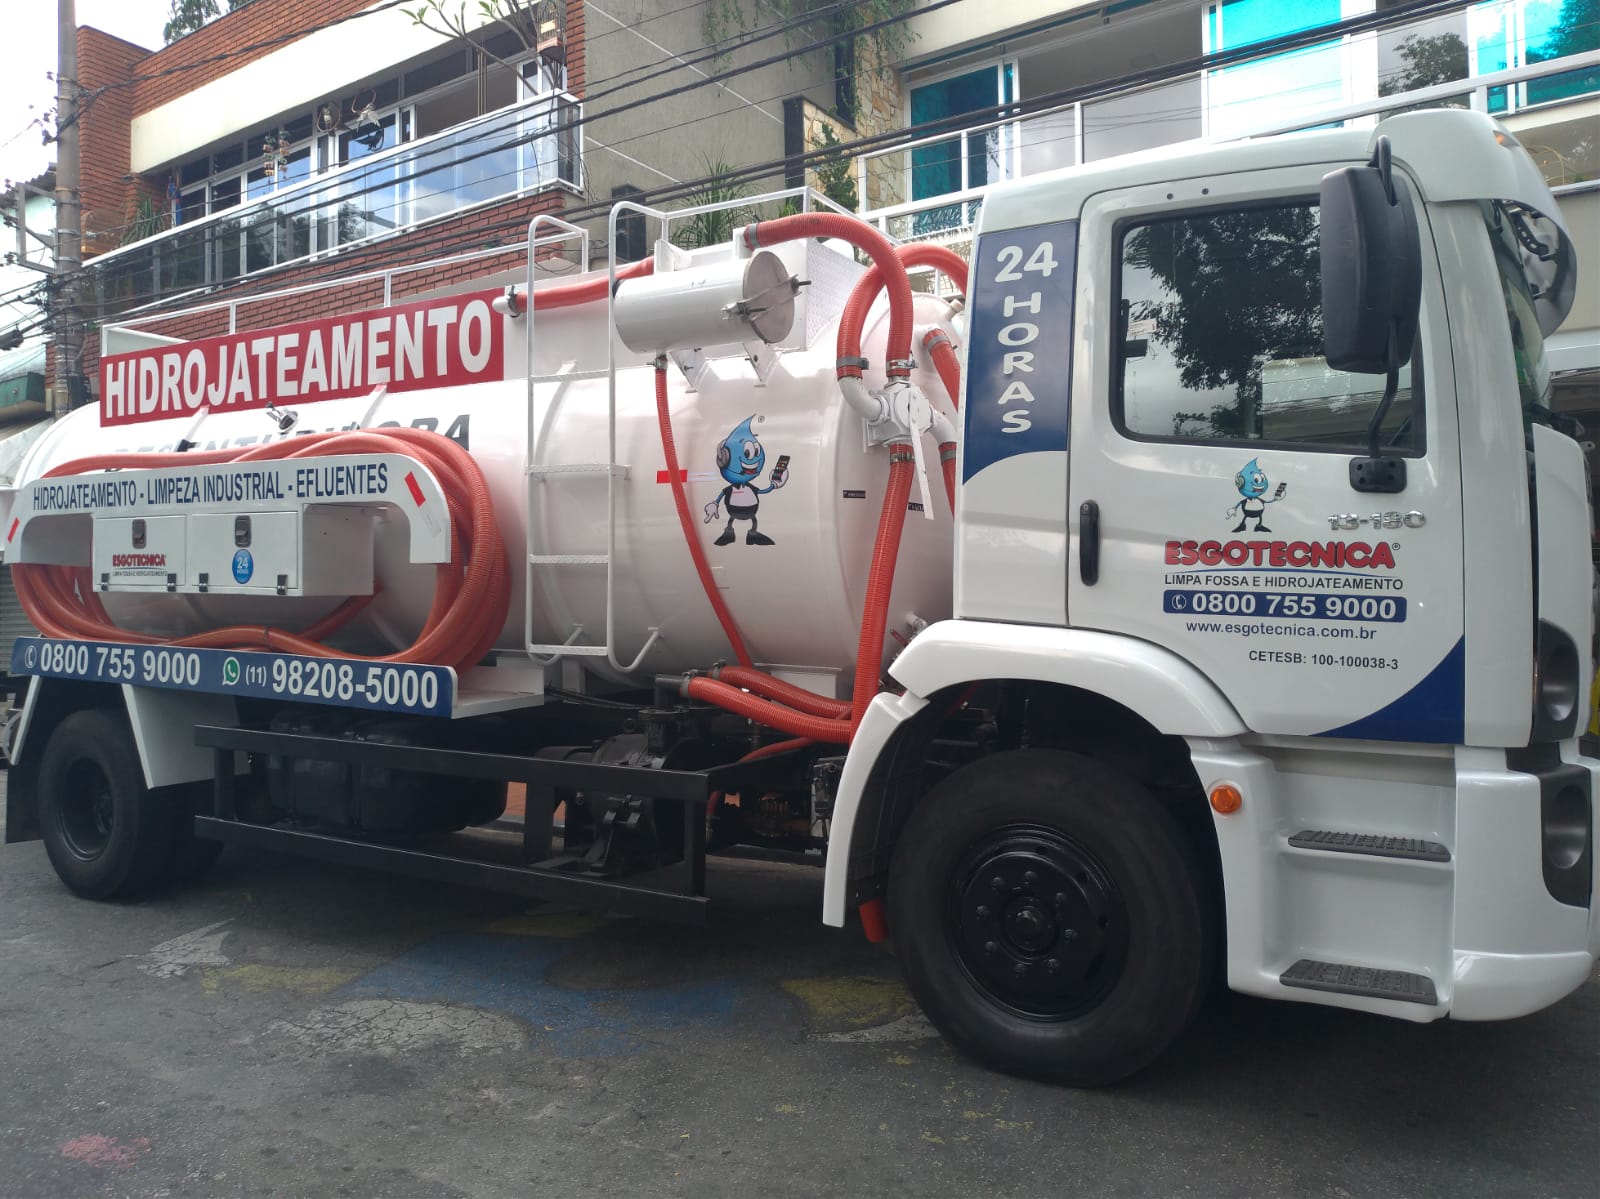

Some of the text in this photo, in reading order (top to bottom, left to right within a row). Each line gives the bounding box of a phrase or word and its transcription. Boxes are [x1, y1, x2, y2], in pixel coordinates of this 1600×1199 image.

[995, 241, 1058, 283] 24
[105, 299, 492, 419] HIDROJATEAMENTO
[998, 291, 1042, 433] HORAS
[33, 481, 137, 511] HIDROJATEAMENTO
[147, 473, 200, 505] LIMPEZA
[203, 470, 284, 502] INDUSTRIAL
[297, 462, 388, 498] EFLUENTES
[237, 556, 248, 570] 24
[1164, 540, 1396, 569] ESGOTECNICA
[1164, 574, 1403, 590] LIMPA FOSSA E HIDROJATEAMENTO
[1192, 592, 1397, 619] 0800 755 9000
[1186, 622, 1377, 639] www.esgotecnica.com.br
[40, 643, 200, 686] 0800 755 9000
[1249, 650, 1399, 670] CETESB: 100-100038-3
[245, 658, 439, 709] (11) 98208-5000
